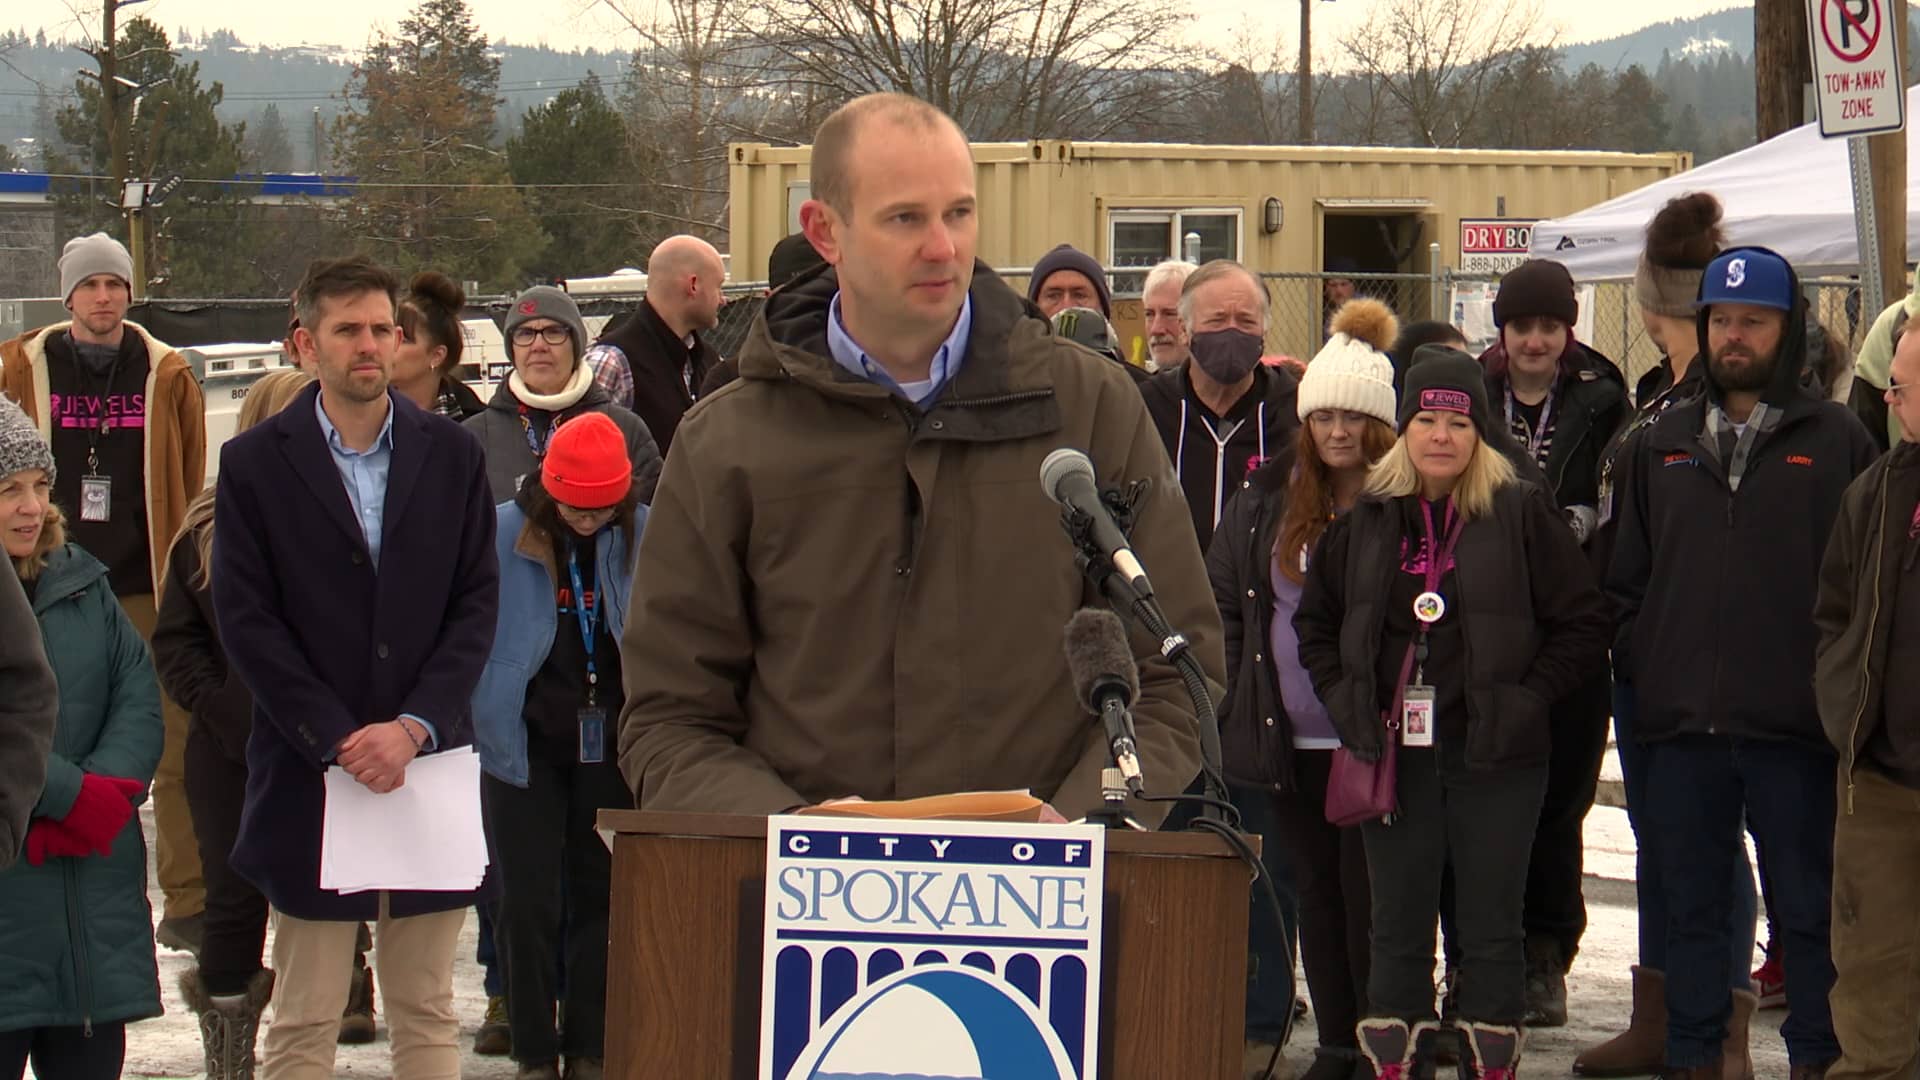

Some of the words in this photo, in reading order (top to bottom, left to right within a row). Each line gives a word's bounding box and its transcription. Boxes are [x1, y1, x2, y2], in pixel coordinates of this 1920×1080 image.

[1825, 70, 1886, 94] TOW-AWAY
[1841, 98, 1874, 119] ZONE
[1726, 258, 1746, 288] S
[62, 395, 144, 415] JEWELS
[1435, 393, 1470, 405] JEWELS
[788, 835, 952, 859] CITY
[1012, 842, 1083, 863] OF
[777, 866, 1089, 931] SPOKANE
